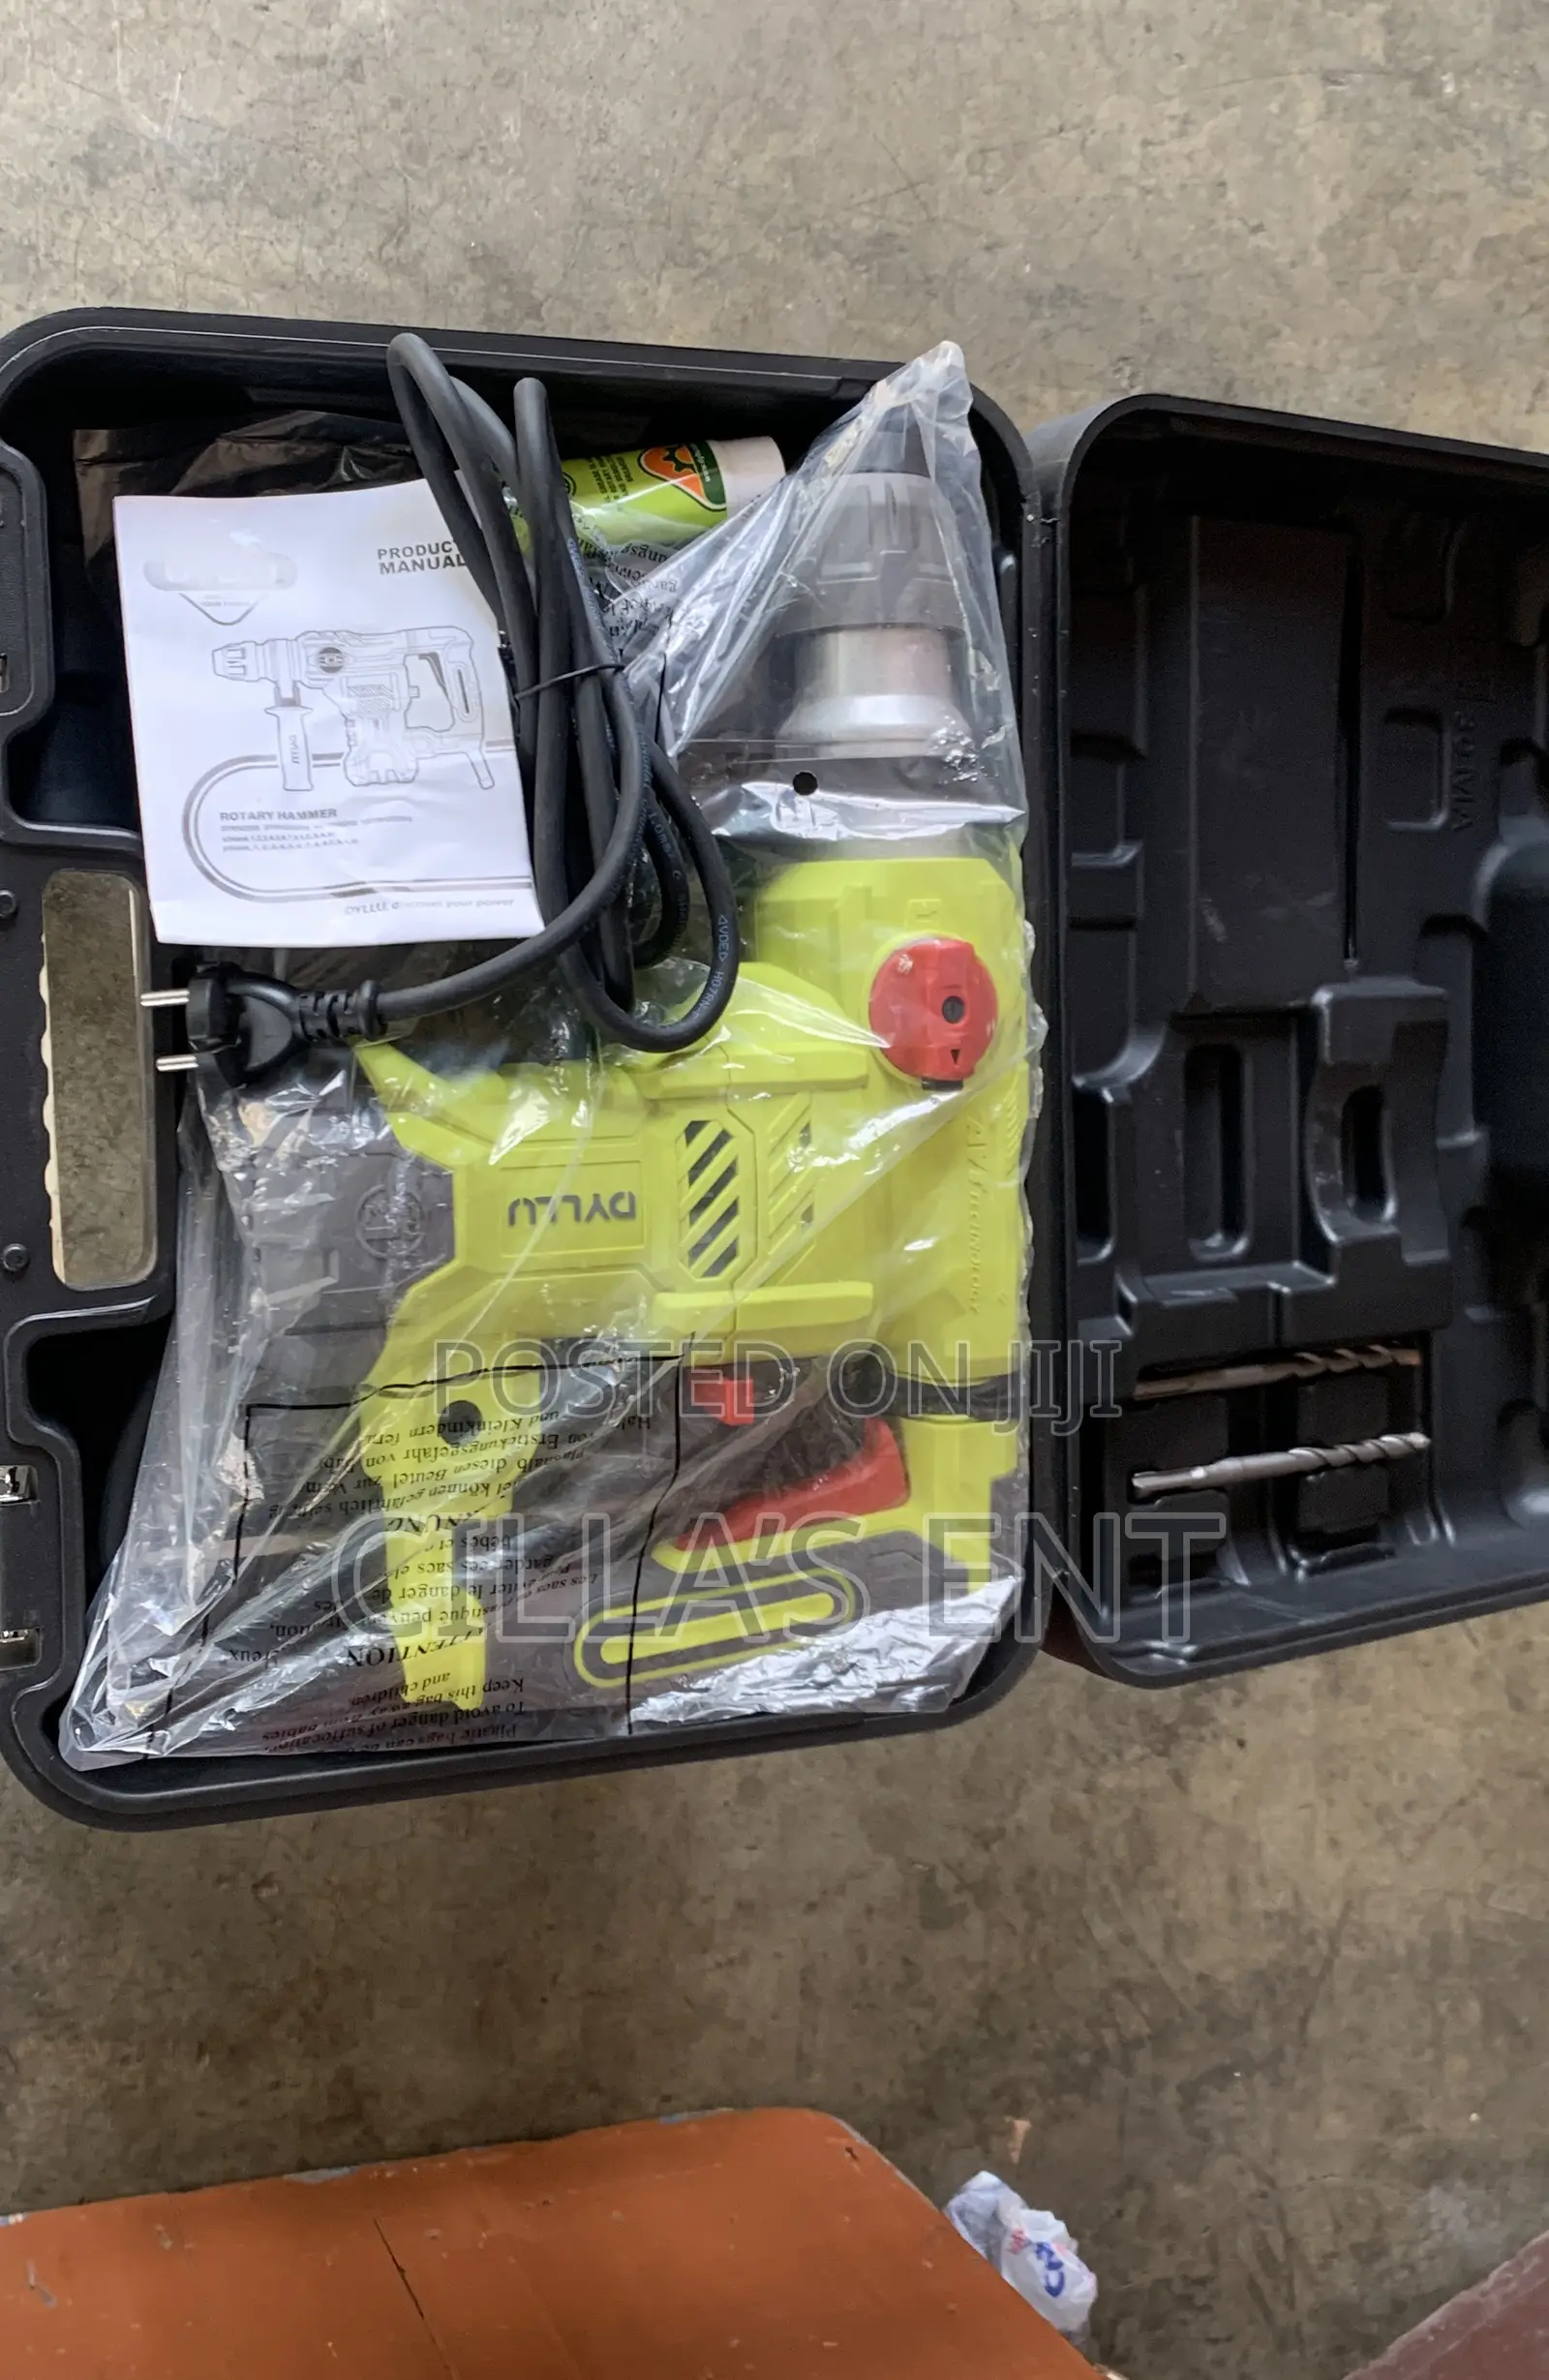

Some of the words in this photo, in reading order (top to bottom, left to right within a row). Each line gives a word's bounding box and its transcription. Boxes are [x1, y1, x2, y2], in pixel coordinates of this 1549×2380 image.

[377, 540, 456, 561] PRODUC
[379, 553, 466, 575] MANUAL
[220, 810, 275, 822] ROTARY
[277, 809, 338, 821] HAMMER
[508, 1191, 637, 1227] DYLLU
[403, 1434, 560, 1465] Erstickungsgefahr
[366, 1453, 395, 1468] von
[455, 1458, 507, 1474] diesen
[393, 1469, 448, 1489] Beutel
[399, 1583, 460, 1603] danger
[421, 1672, 450, 1691] and
[482, 1678, 524, 1693] Keep
[415, 1693, 443, 1706] bag
[448, 1685, 475, 1700] this
[454, 1705, 501, 1724] avoid
[505, 1701, 524, 1716] To
[390, 1712, 448, 1728] danger
